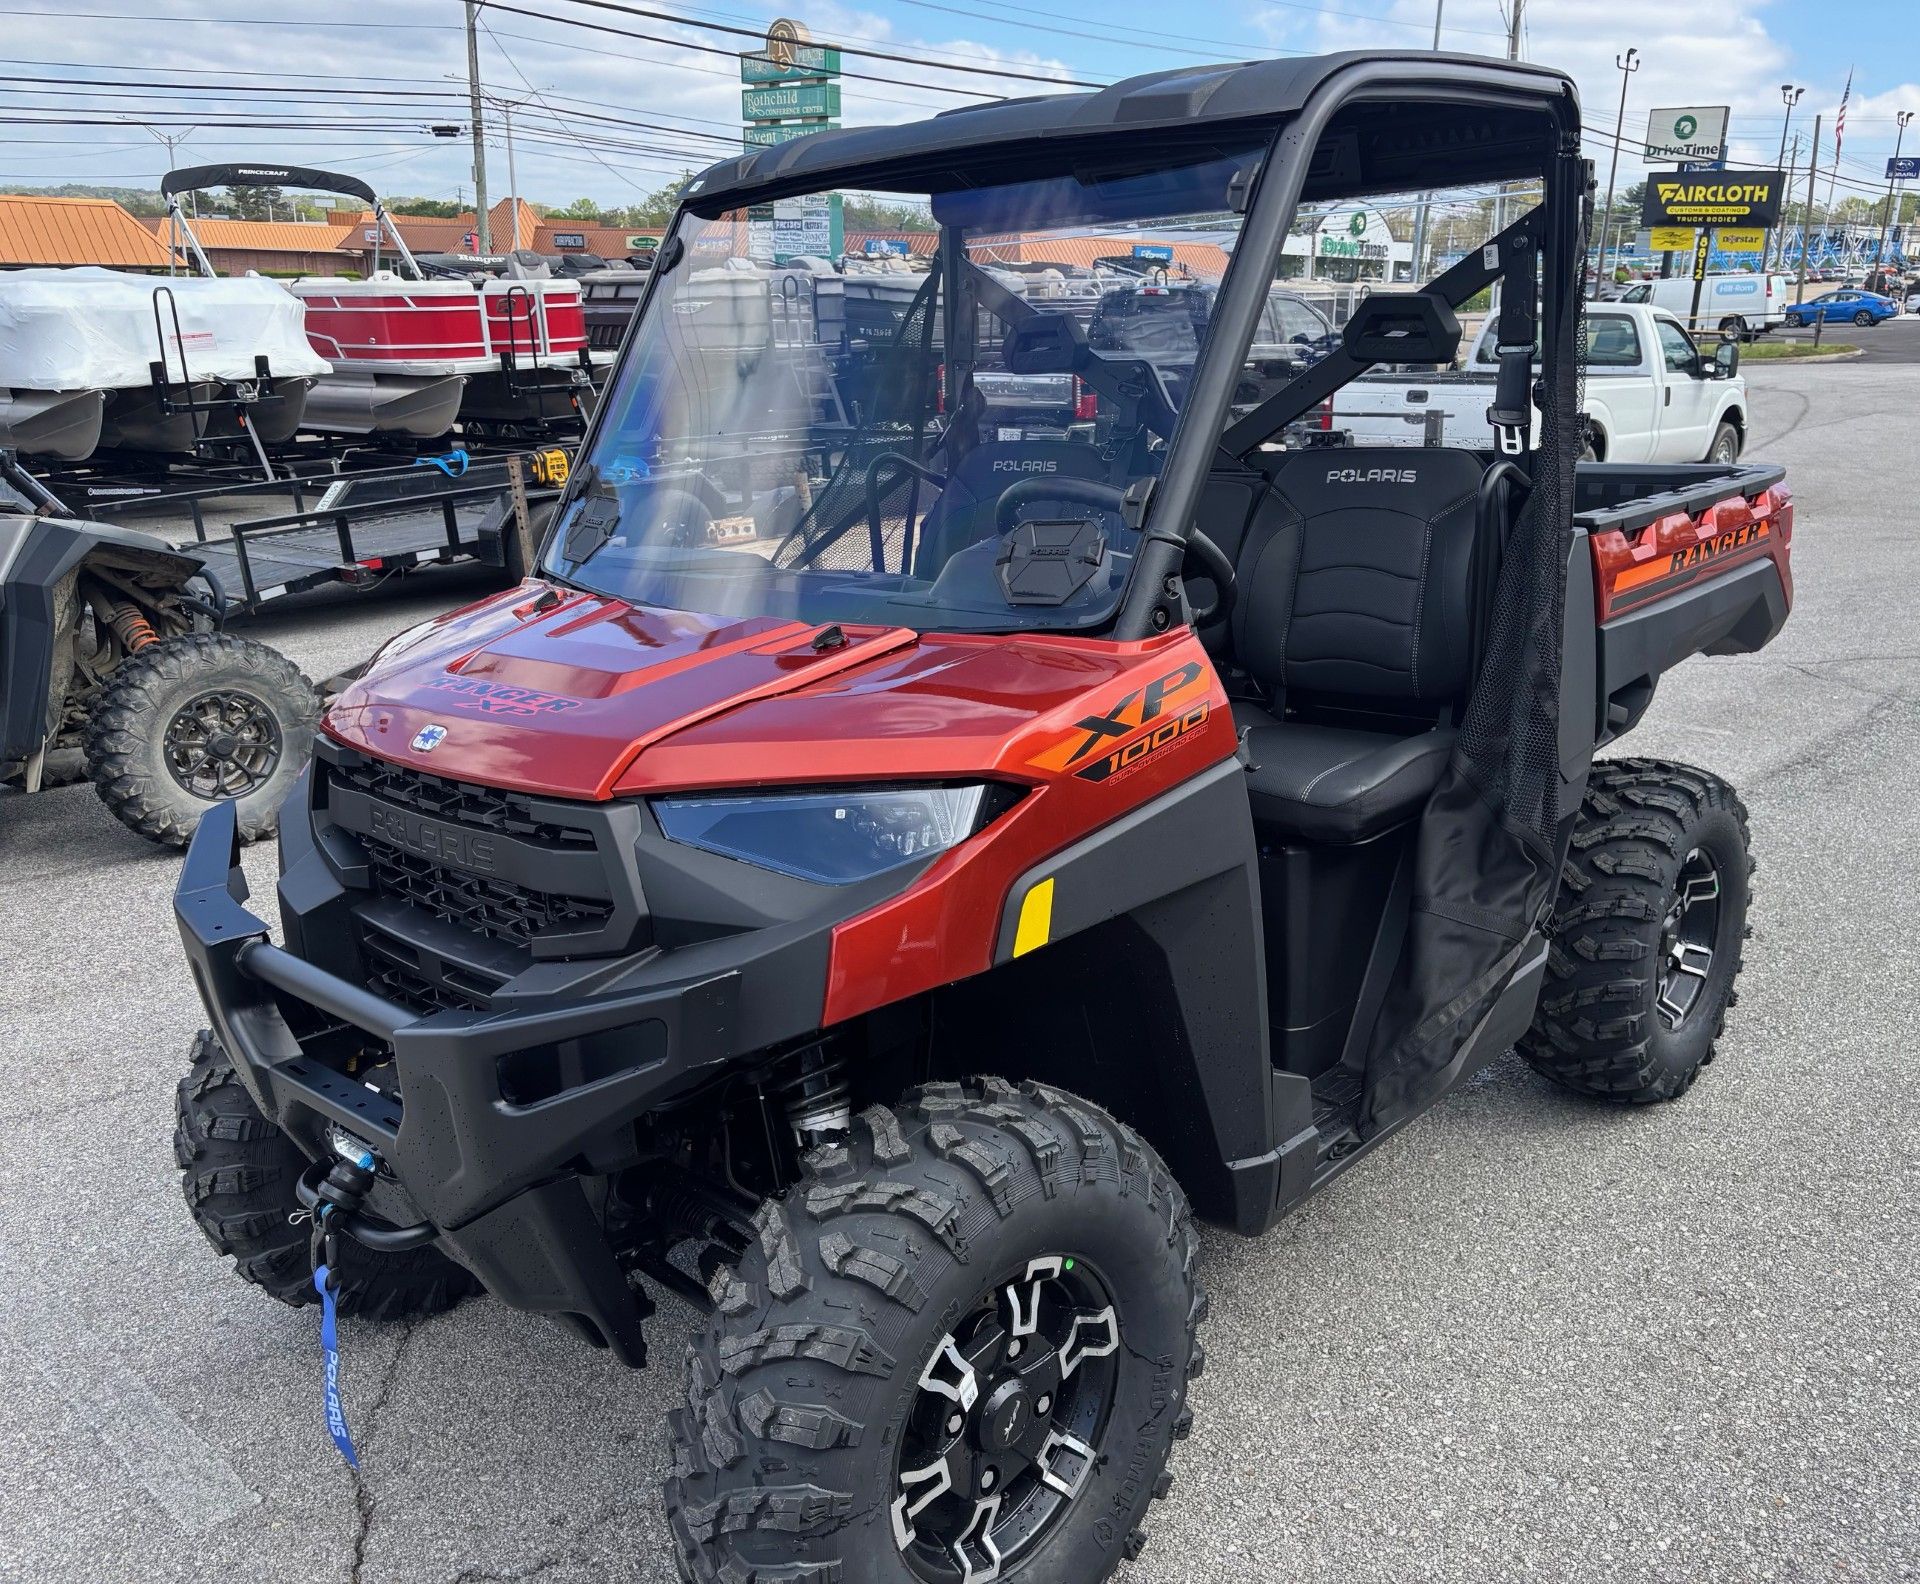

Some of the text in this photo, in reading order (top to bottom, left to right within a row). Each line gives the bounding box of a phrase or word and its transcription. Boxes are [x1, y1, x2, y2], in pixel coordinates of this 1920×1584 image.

[744, 90, 798, 109] Rothchild
[765, 105, 824, 116] CONFERENCE CENTER
[745, 129, 777, 143] Event
[1645, 143, 1719, 157] DriveTime
[1657, 183, 1770, 205] FAIRCLOTH
[1321, 236, 1389, 257] DriveTime
[457, 253, 505, 265] Ranger
[1694, 236, 1708, 280] 8812
[993, 460, 1057, 472] POLARIS
[1326, 469, 1417, 483] POLARIS
[1669, 519, 1762, 574] RANGER
[417, 676, 583, 714] RANGER
[1063, 661, 1204, 767] XP
[1109, 702, 1210, 774] 1000
[370, 804, 496, 871] POLARIS
[327, 1349, 347, 1438] POLARIS
